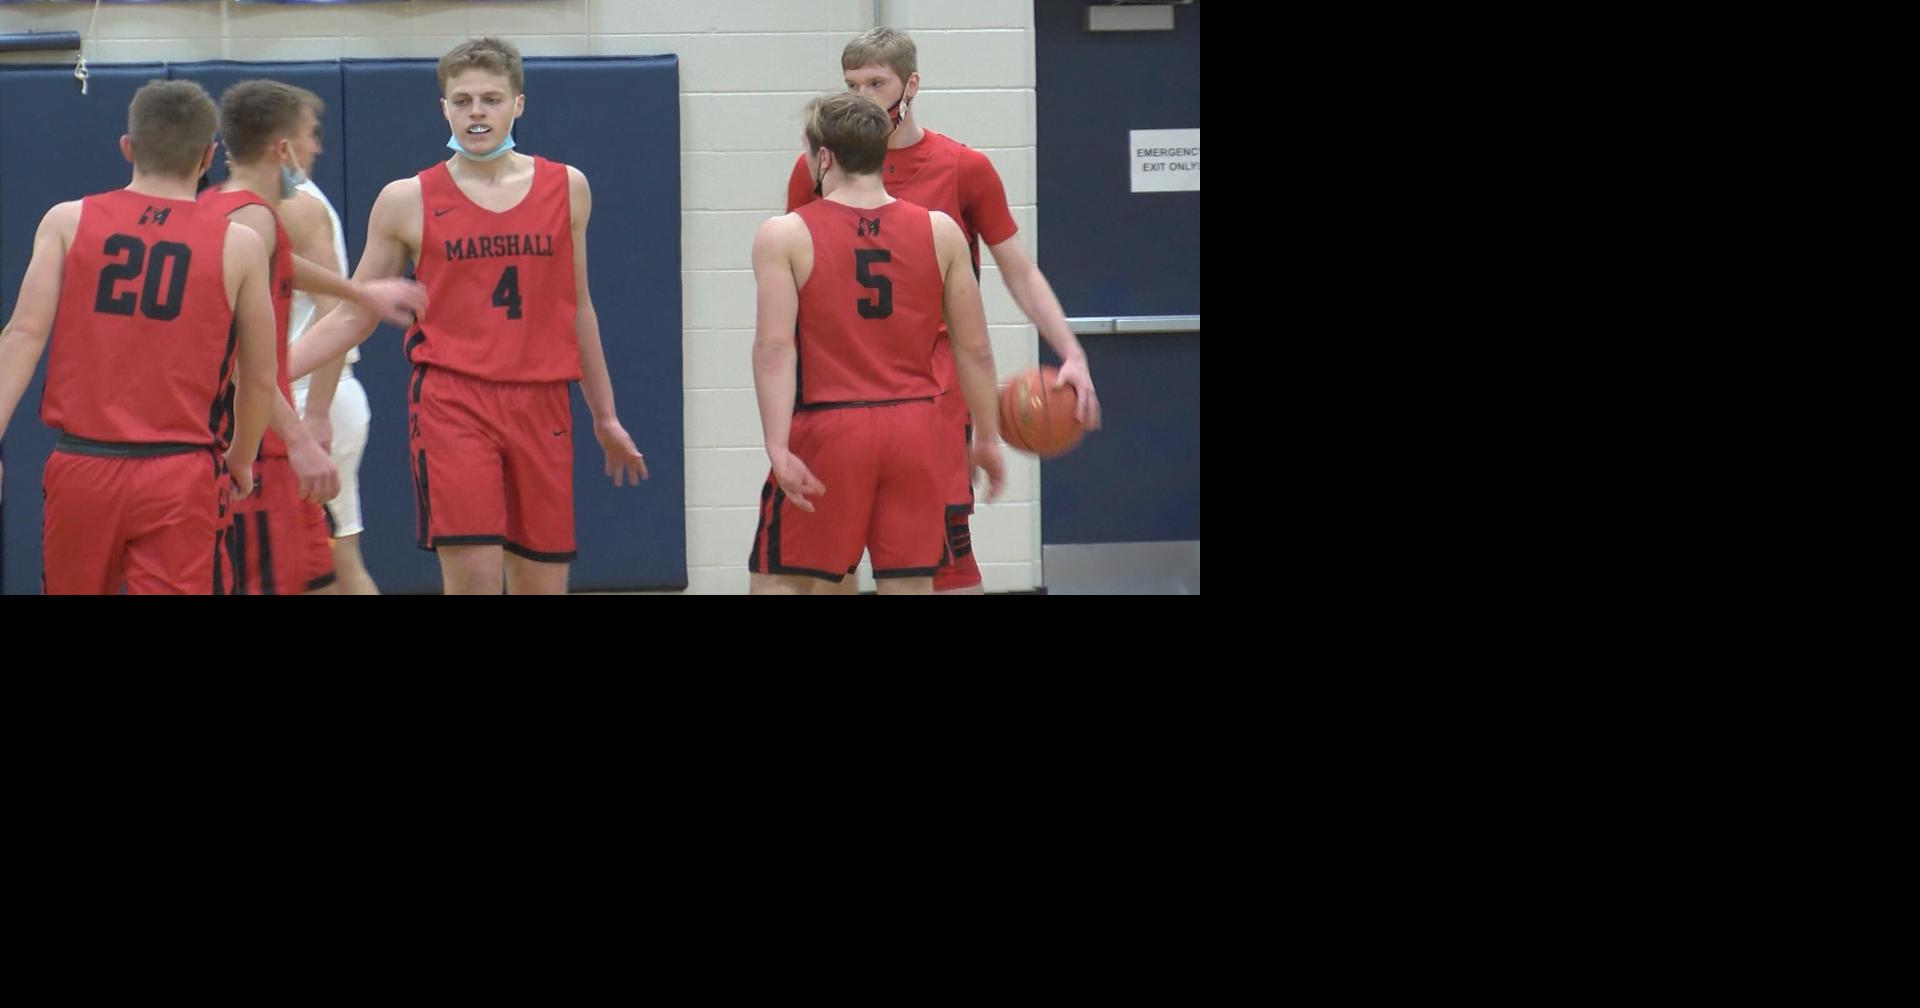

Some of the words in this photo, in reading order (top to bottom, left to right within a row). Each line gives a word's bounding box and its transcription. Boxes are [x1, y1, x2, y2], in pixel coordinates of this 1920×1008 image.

[1136, 147, 1200, 157] EMERGENC
[1143, 162, 1165, 172] EXIT
[444, 234, 554, 262] MARSHALL
[94, 233, 192, 321] 20
[491, 265, 522, 320] 4
[854, 248, 893, 320] 5
